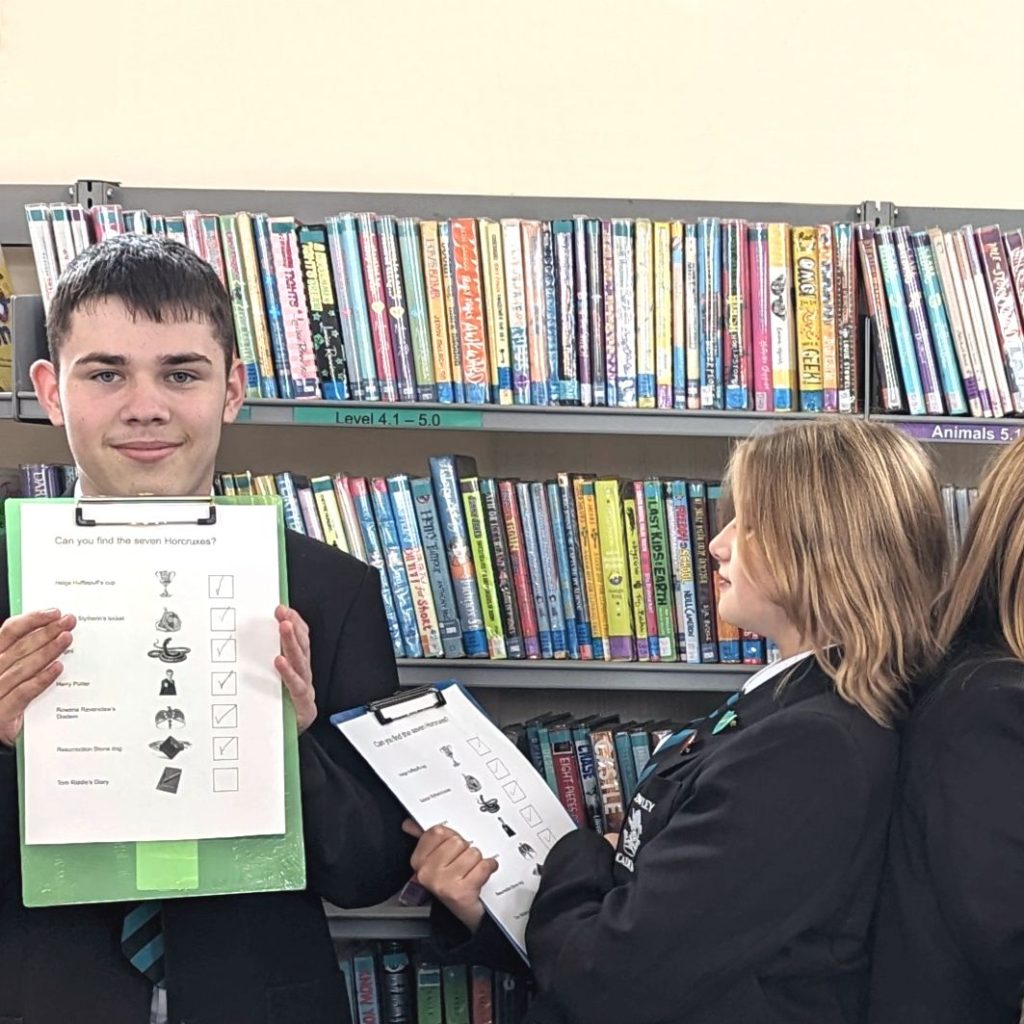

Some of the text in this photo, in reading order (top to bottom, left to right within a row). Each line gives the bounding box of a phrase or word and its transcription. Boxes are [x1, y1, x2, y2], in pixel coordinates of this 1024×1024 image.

[798, 257, 822, 386] OMG! GEEK!
[462, 322, 486, 384] AWKWARD
[335, 411, 441, 427] Level 4.1 5.0
[931, 424, 995, 440] Animals
[55, 536, 74, 546] Can
[77, 538, 93, 547] you
[97, 536, 114, 545] find
[117, 536, 131, 545] the
[164, 536, 216, 546] Horcruxes?
[649, 501, 668, 606] LAST EARTH
[679, 548, 692, 585] SCHOOL
[683, 590, 696, 638] NEILL CAMERON
[401, 730, 411, 738] the
[578, 745, 594, 780] CHASE
[594, 740, 622, 814] CASTLE
[559, 757, 578, 813] EIGHT PIECES
[358, 970, 372, 1005] KNOW
